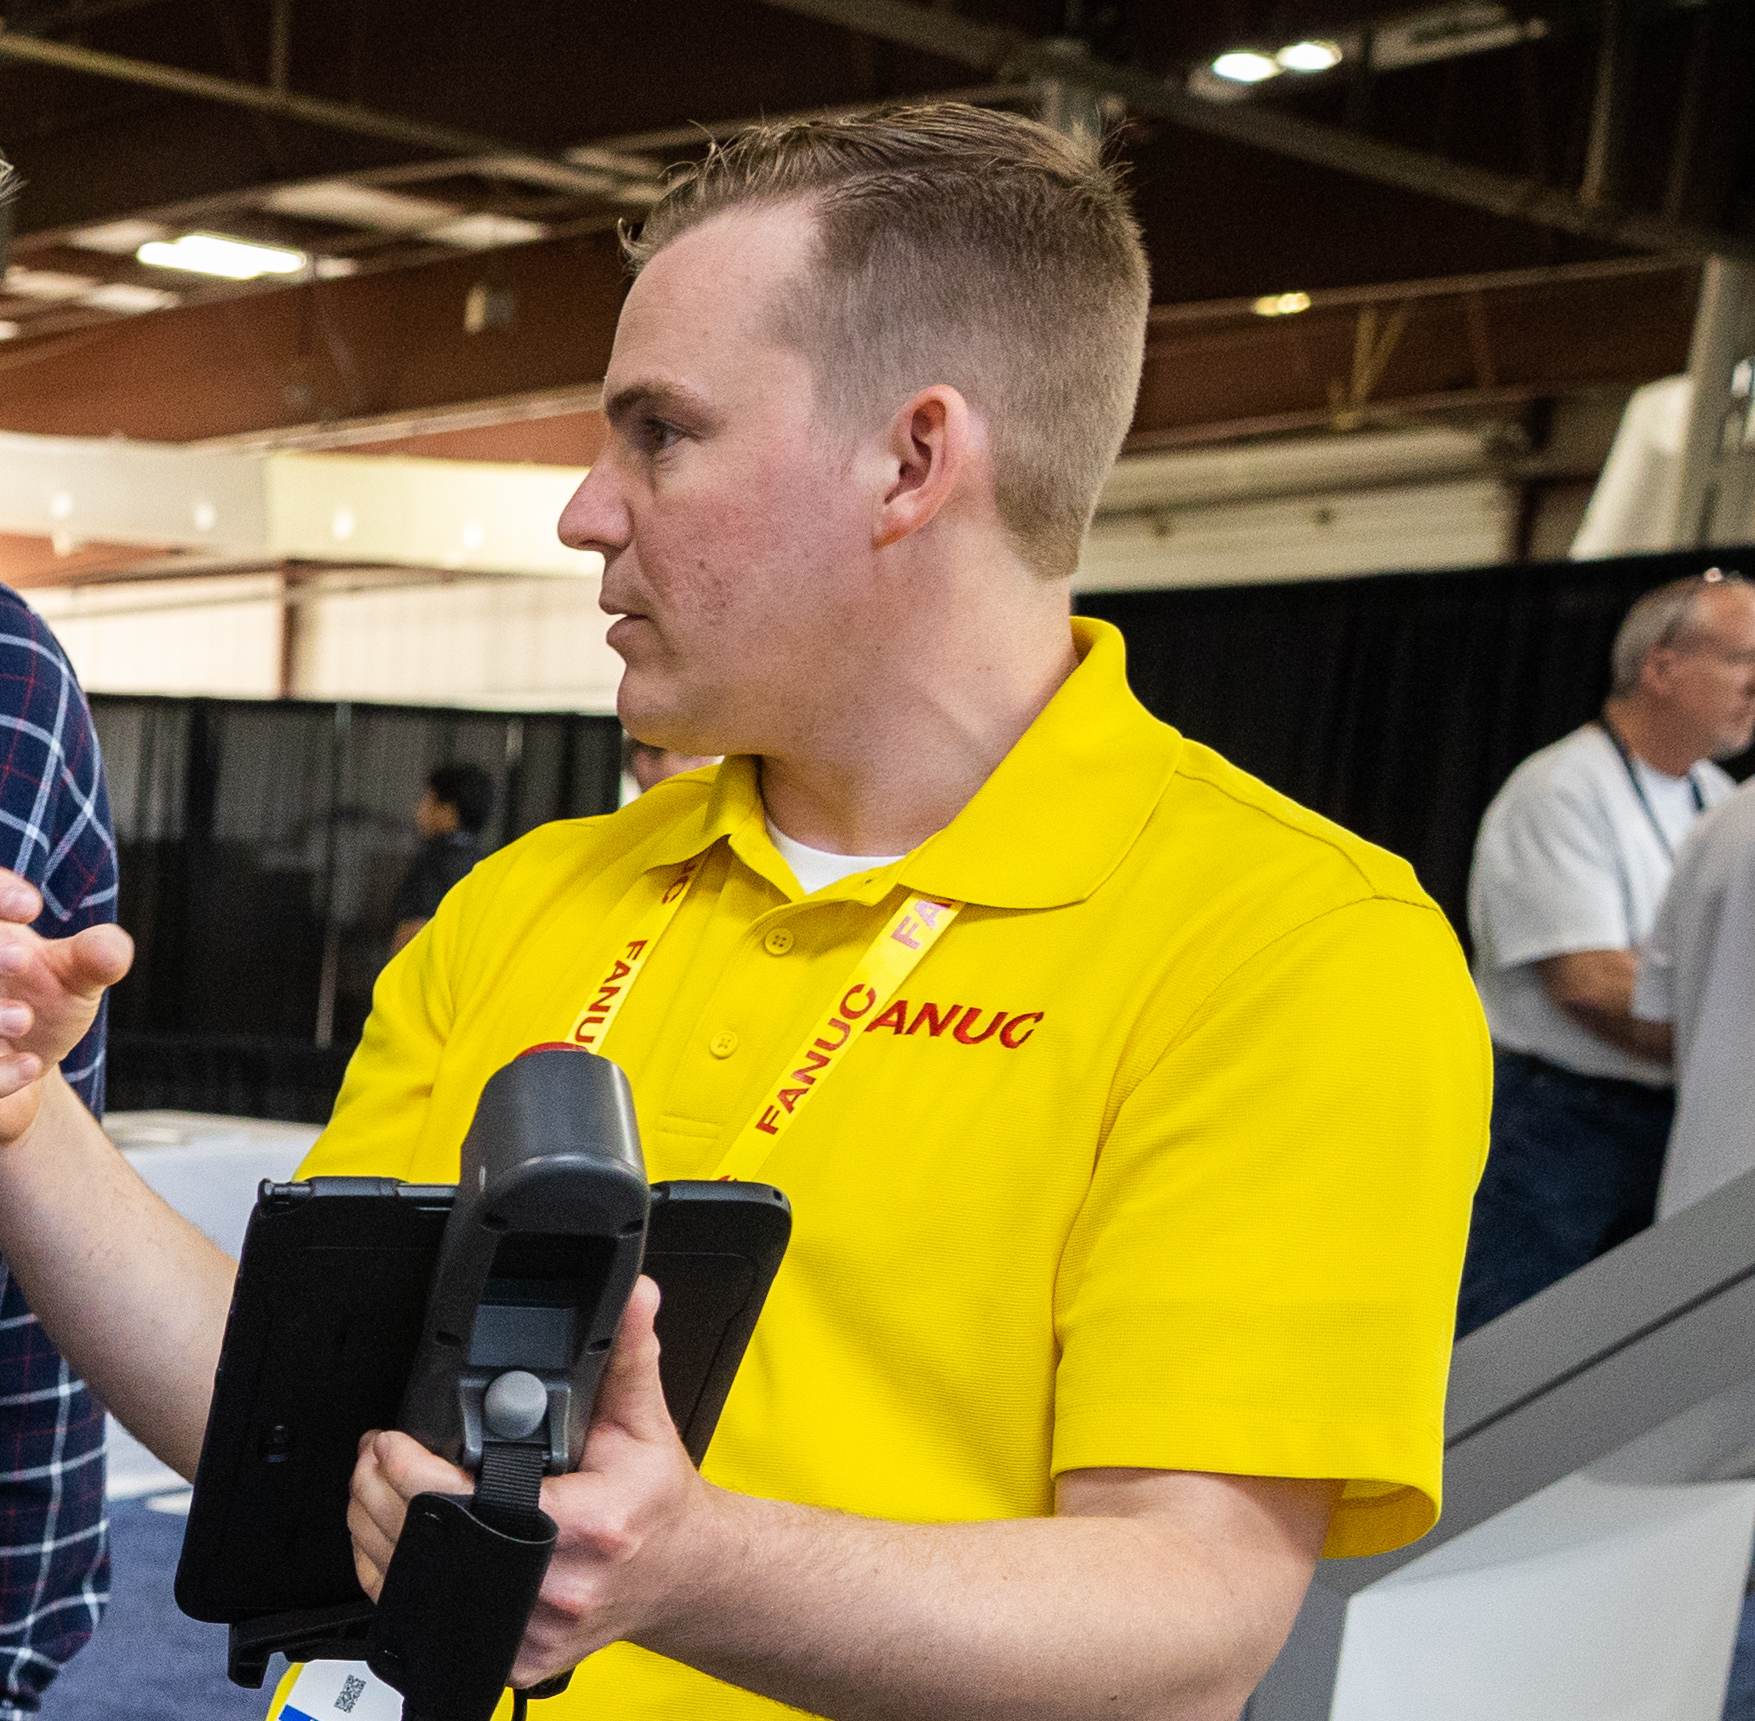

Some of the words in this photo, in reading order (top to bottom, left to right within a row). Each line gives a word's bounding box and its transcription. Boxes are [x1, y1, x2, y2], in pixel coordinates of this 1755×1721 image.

[574, 939, 649, 1044] FANU
[864, 999, 1045, 1050] ANUC
[754, 983, 877, 1136] FANUC
